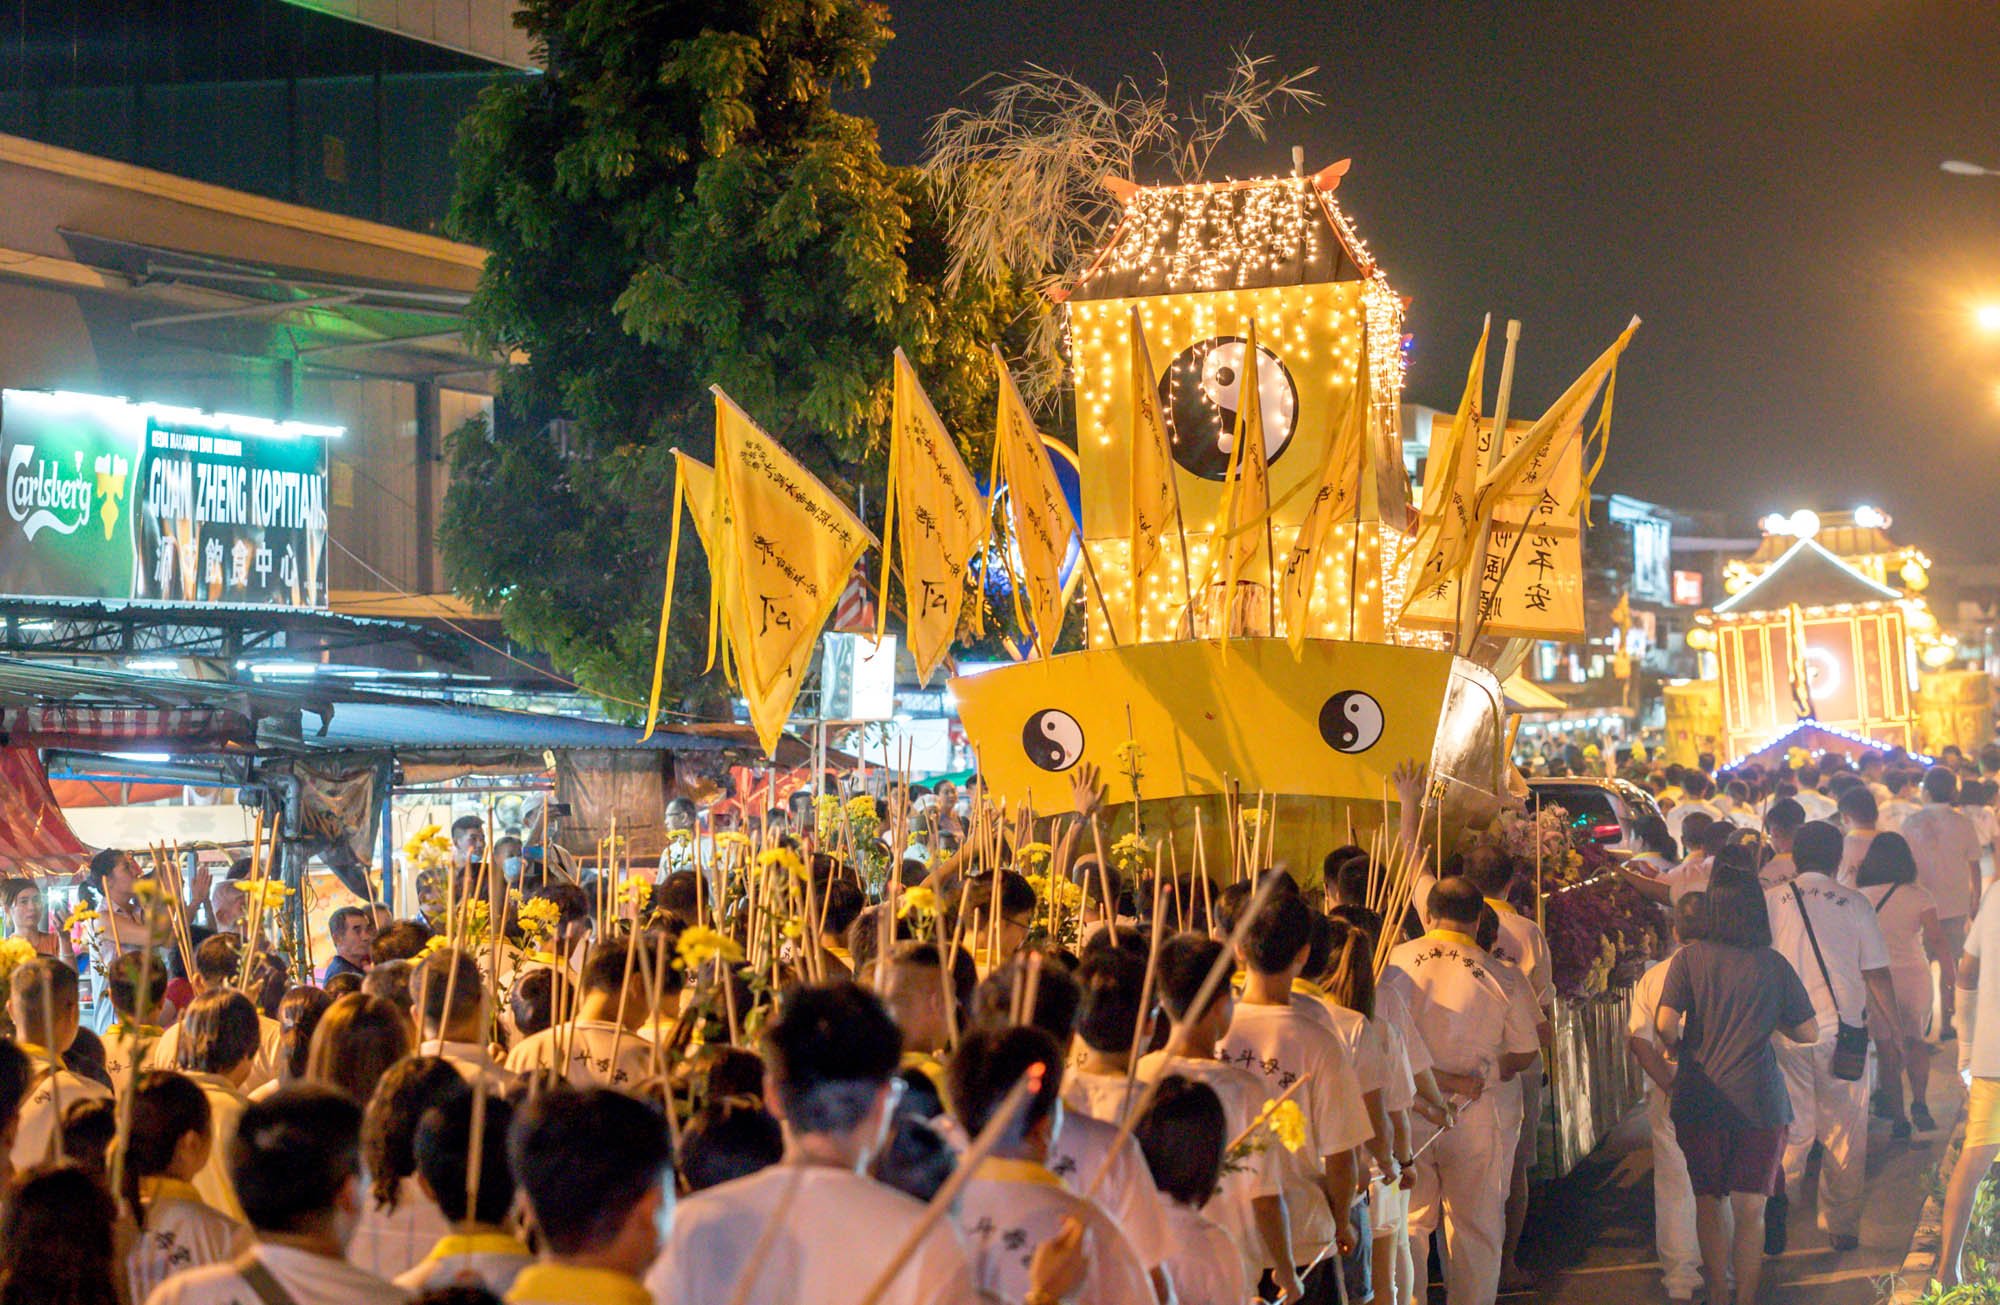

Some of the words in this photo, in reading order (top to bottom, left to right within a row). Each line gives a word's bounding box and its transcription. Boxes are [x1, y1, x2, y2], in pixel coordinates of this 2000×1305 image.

[7, 444, 93, 528] Carlsberg
[150, 456, 192, 520] GUAN
[197, 462, 247, 525] ZHENG
[252, 468, 324, 530] KOPITIAM
